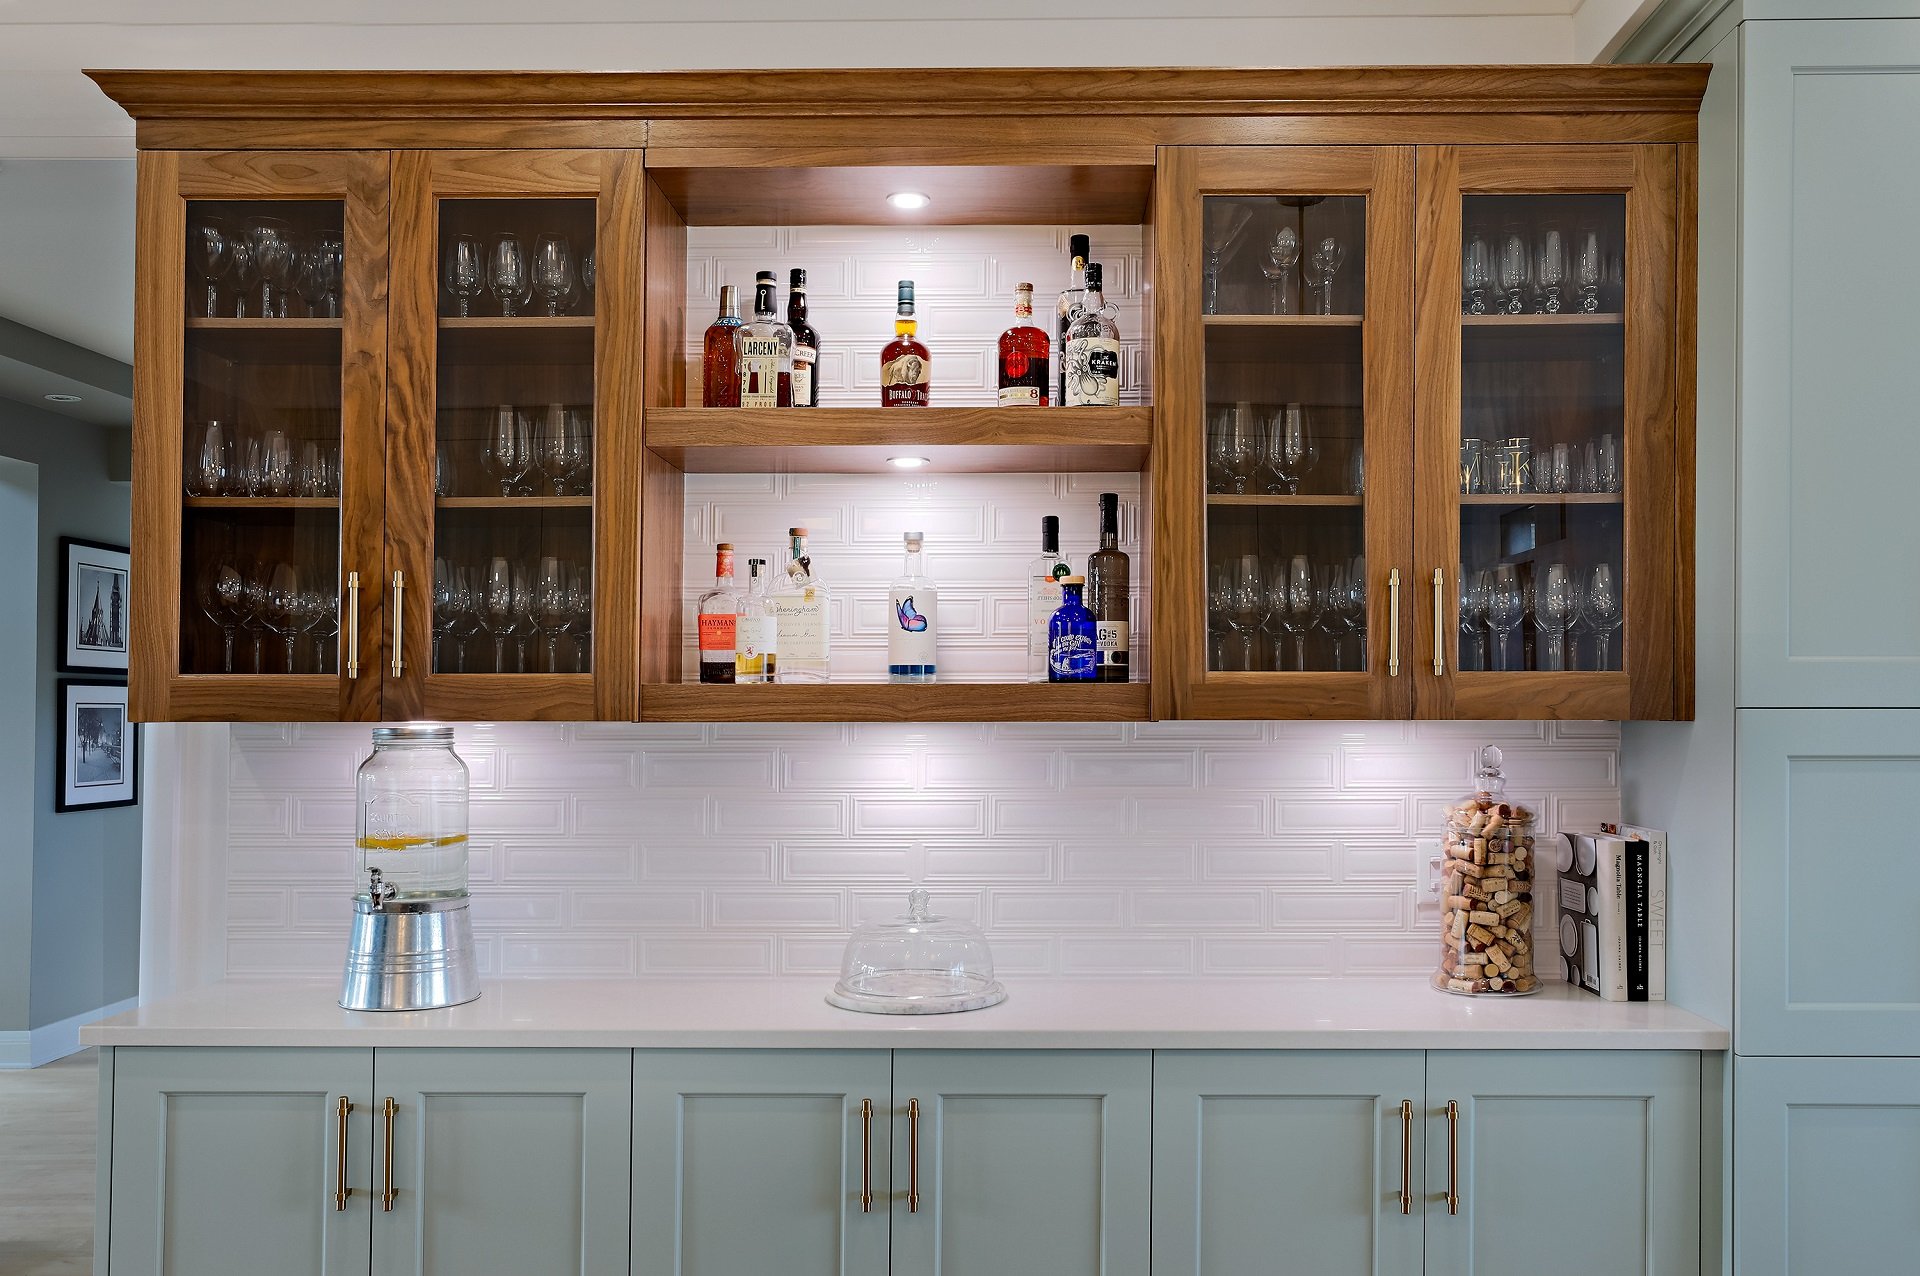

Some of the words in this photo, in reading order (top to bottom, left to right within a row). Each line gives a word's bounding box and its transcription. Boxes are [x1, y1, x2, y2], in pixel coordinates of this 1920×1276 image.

[743, 341, 777, 355] LARCENY
[794, 349, 815, 359] CREEK
[889, 389, 911, 400] BUFFALO
[1030, 388, 1039, 399] 8
[1650, 889, 1664, 950] SWEET
